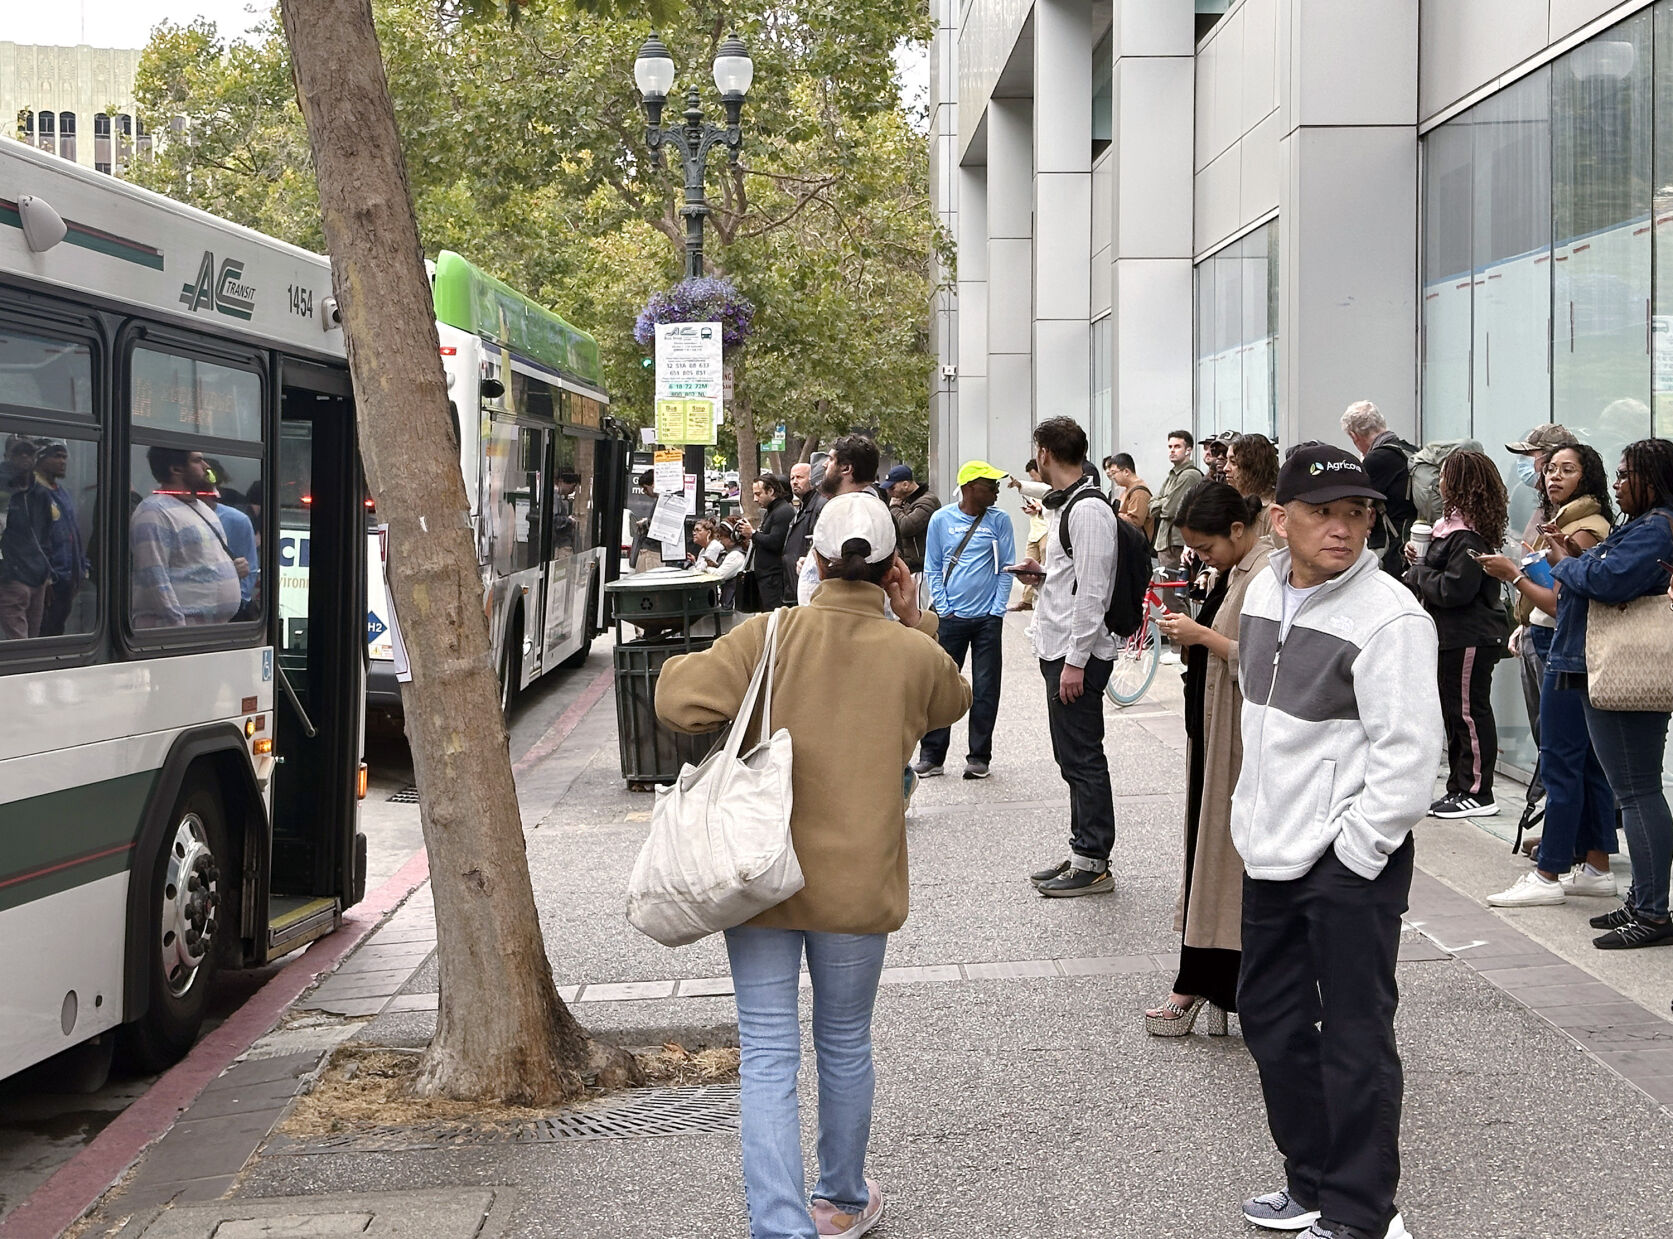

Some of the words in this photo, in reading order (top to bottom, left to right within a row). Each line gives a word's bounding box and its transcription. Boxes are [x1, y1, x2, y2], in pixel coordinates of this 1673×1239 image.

[179, 250, 255, 321] AC
[226, 281, 256, 300] TRANSIT
[288, 284, 313, 318] 1454
